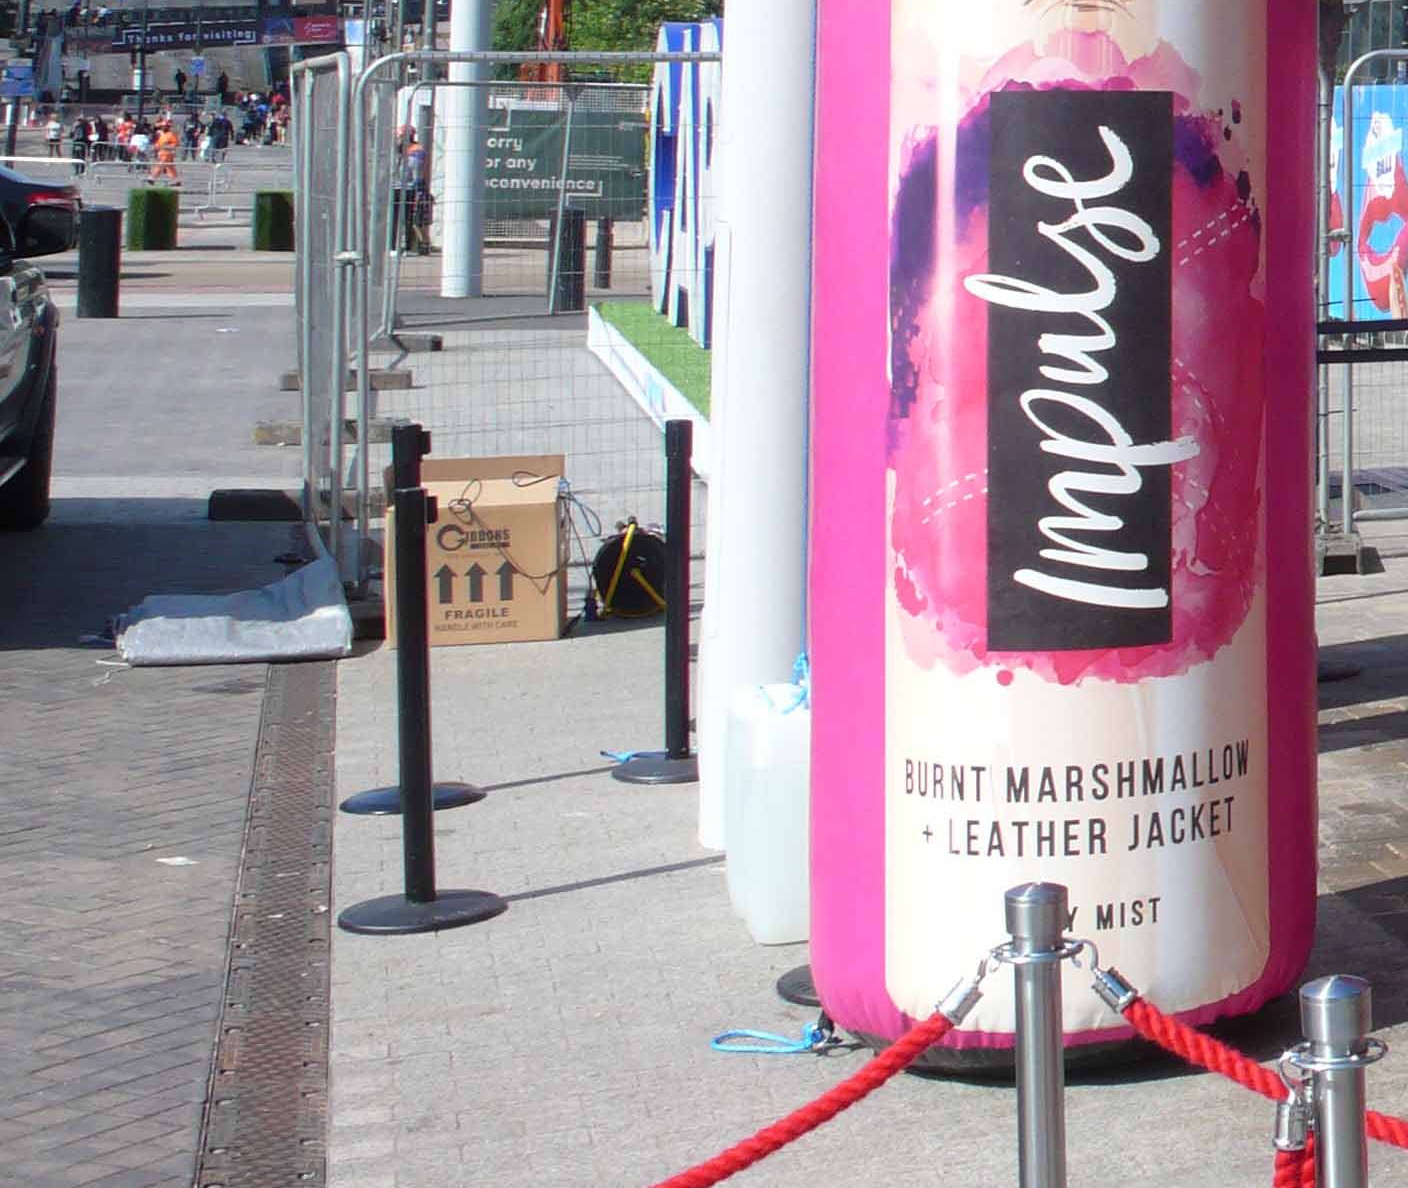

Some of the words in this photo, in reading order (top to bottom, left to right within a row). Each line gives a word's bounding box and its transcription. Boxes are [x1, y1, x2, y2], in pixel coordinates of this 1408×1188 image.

[487, 136, 523, 151] orry
[505, 157, 537, 171] any
[963, 124, 1201, 609] Impulse
[444, 606, 511, 621] FRAGILE
[905, 758, 987, 803] BURNT
[1005, 739, 1250, 804] MARSHMALLOW
[948, 816, 1108, 858] LEATHER
[1127, 796, 1235, 851] JACKET
[1096, 897, 1161, 931] MIST
